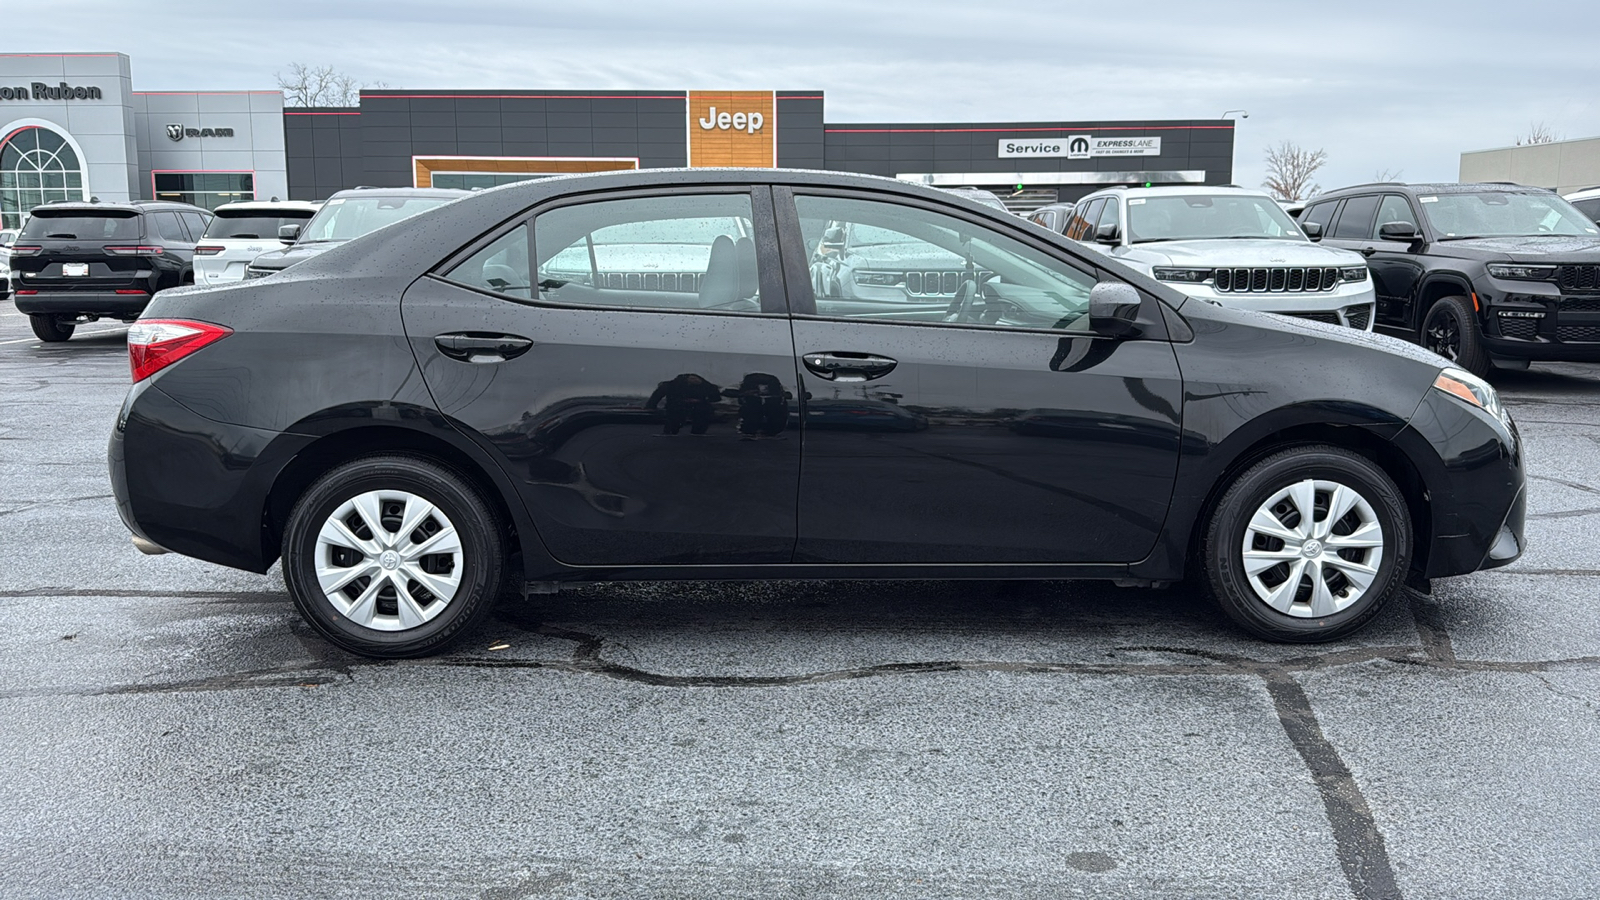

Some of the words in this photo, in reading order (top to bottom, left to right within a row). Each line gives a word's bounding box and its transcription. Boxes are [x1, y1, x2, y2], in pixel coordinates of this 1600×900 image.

[31, 82, 102, 100] Ruben
[699, 106, 764, 134] Jeep
[185, 128, 234, 138] RAM
[1006, 143, 1061, 154] Service
[1097, 140, 1153, 148] EXPRESSLANE
